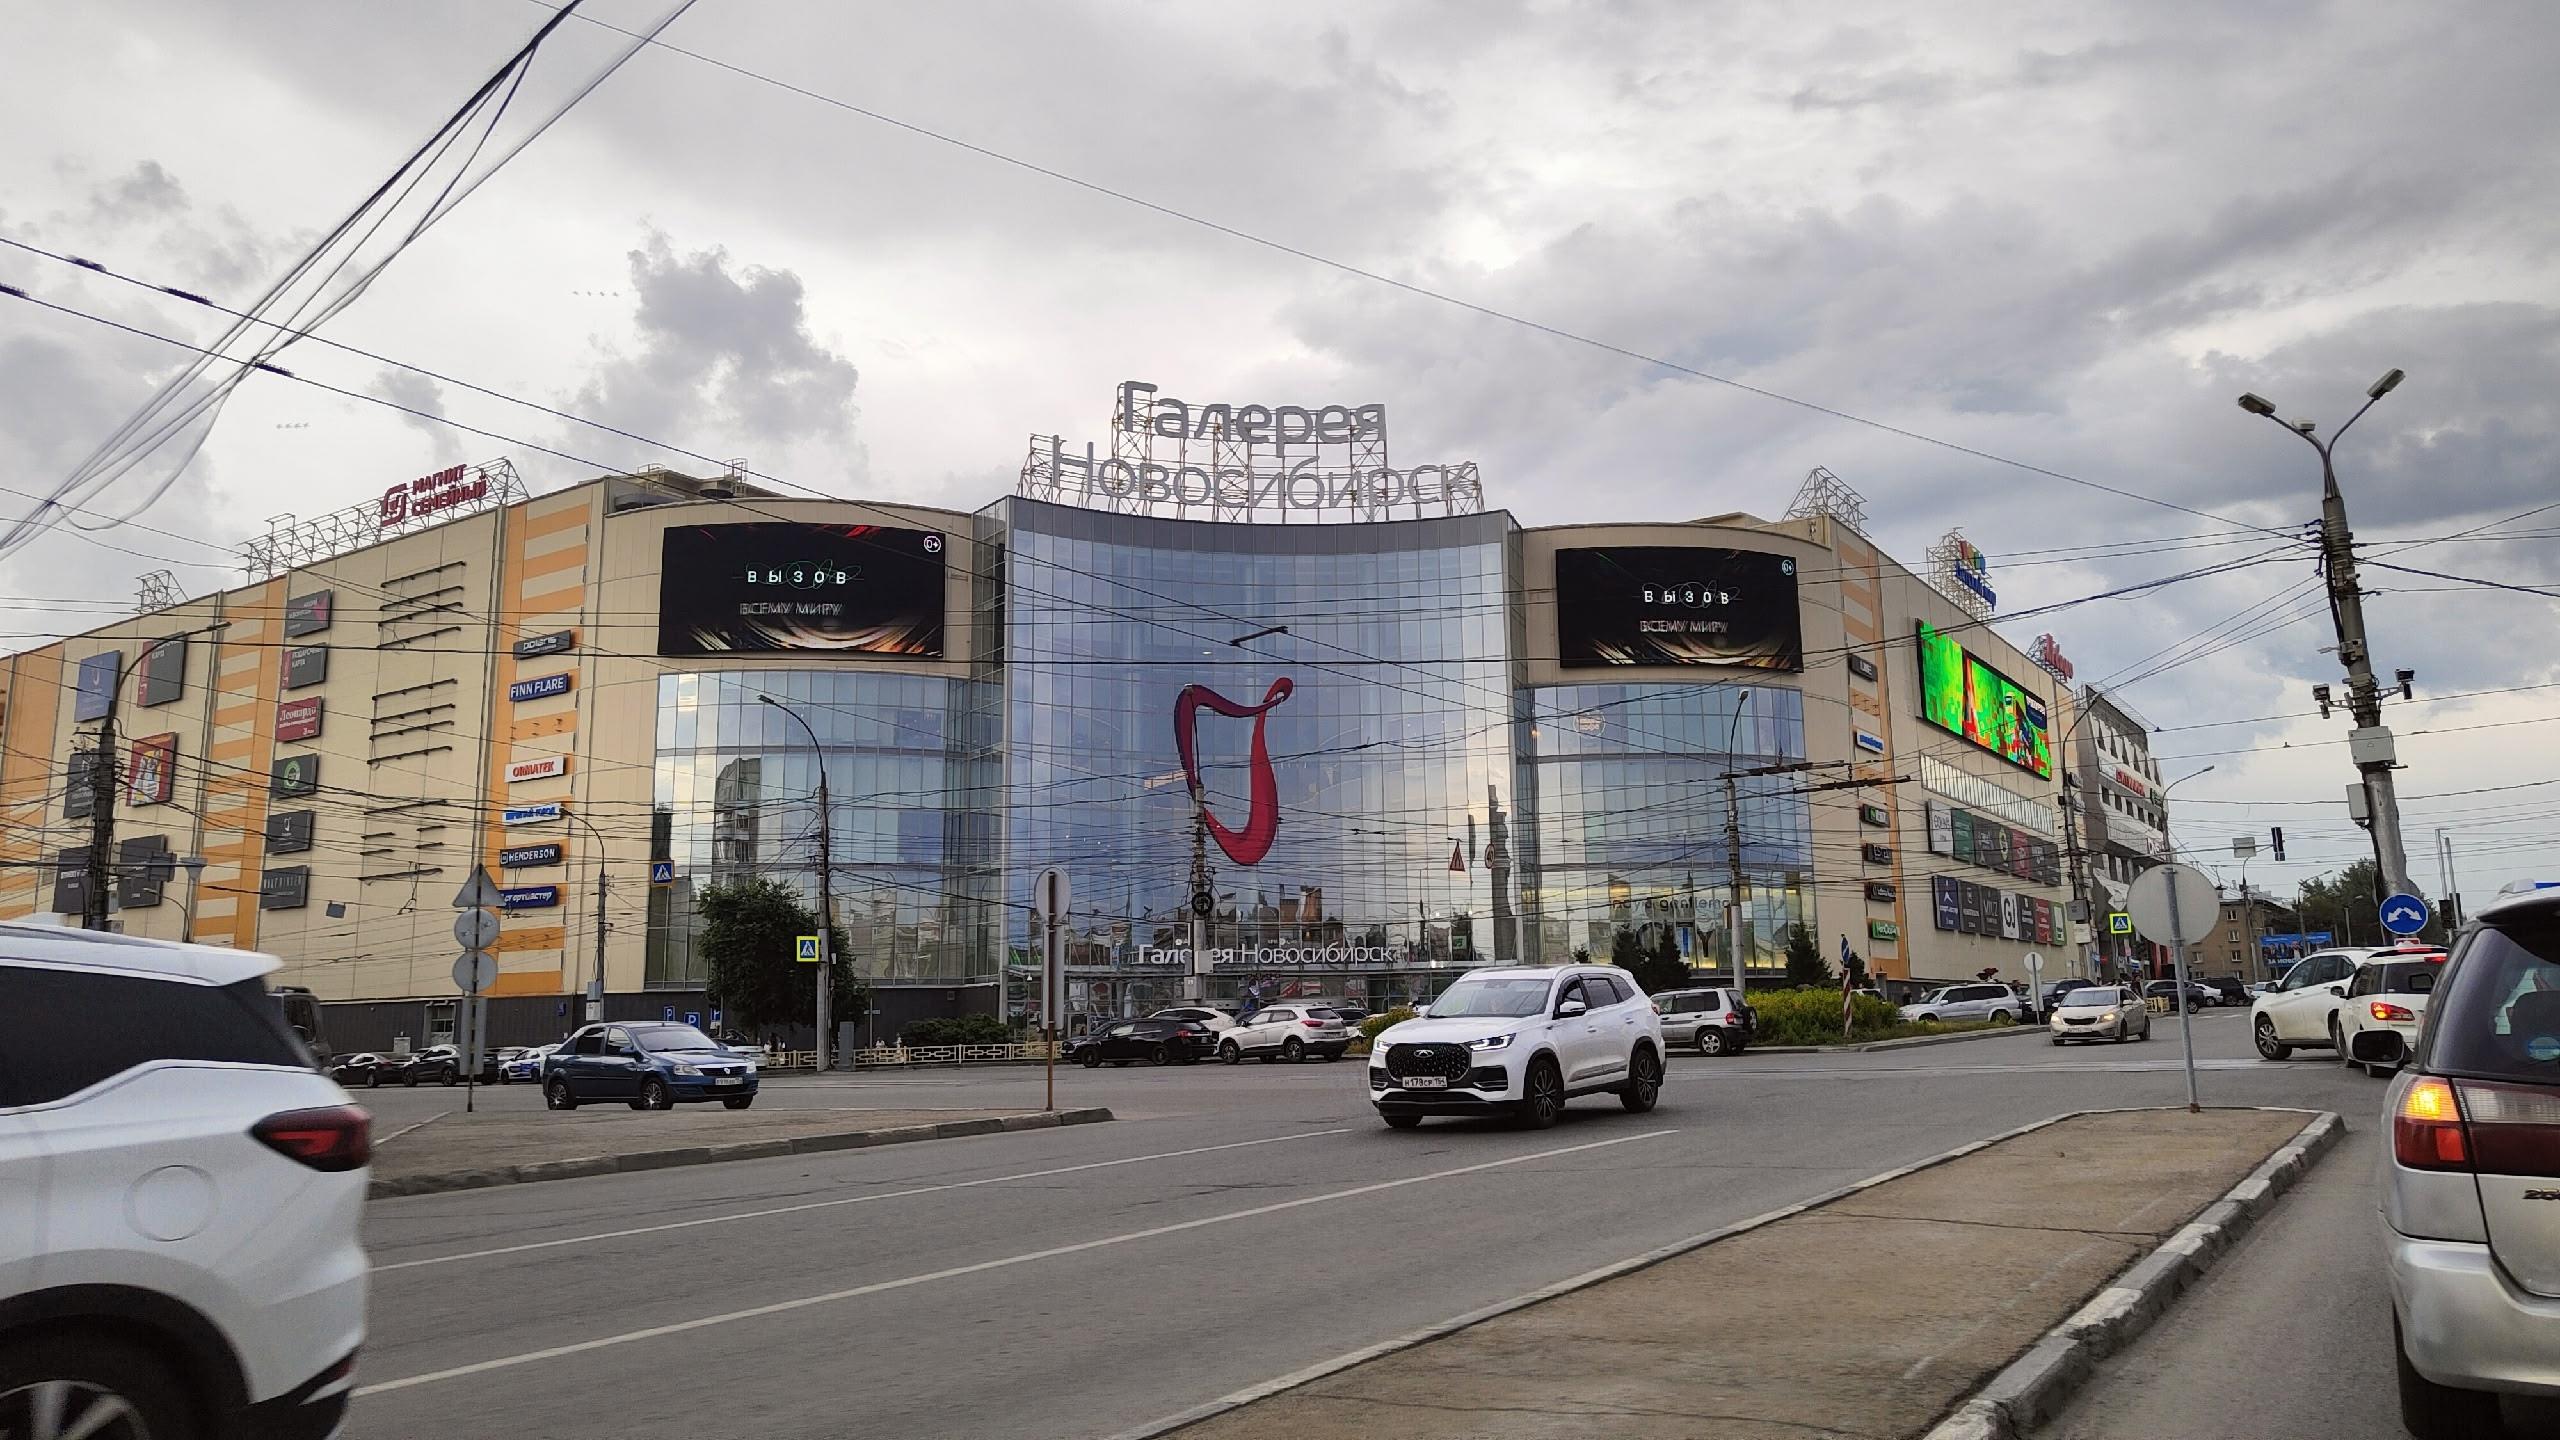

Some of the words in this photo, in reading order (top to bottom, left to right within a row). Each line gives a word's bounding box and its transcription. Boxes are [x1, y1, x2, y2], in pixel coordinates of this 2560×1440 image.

[1123, 381, 1387, 458] Галерея
[412, 464, 467, 495] МАГНИТ
[1053, 435, 1475, 521] Новосибирск
[411, 475, 487, 516] СЕМЕЙНЫЙ
[747, 570, 846, 585] ВЫЗОВ
[1644, 590, 1729, 605] ВЫЗОВ
[739, 602, 793, 615] ВСЕМУ
[796, 602, 842, 616] МИРУ
[1640, 620, 1688, 633] ВСЕМУ
[510, 683, 532, 698] FINN
[535, 677, 564, 693] FLARE
[280, 706, 317, 721] Леонардо
[513, 761, 554, 777] ORMATEK
[509, 849, 555, 862] HENDERSON
[1139, 944, 1234, 964] Галеея
[1241, 941, 1395, 966] Новосибирск
